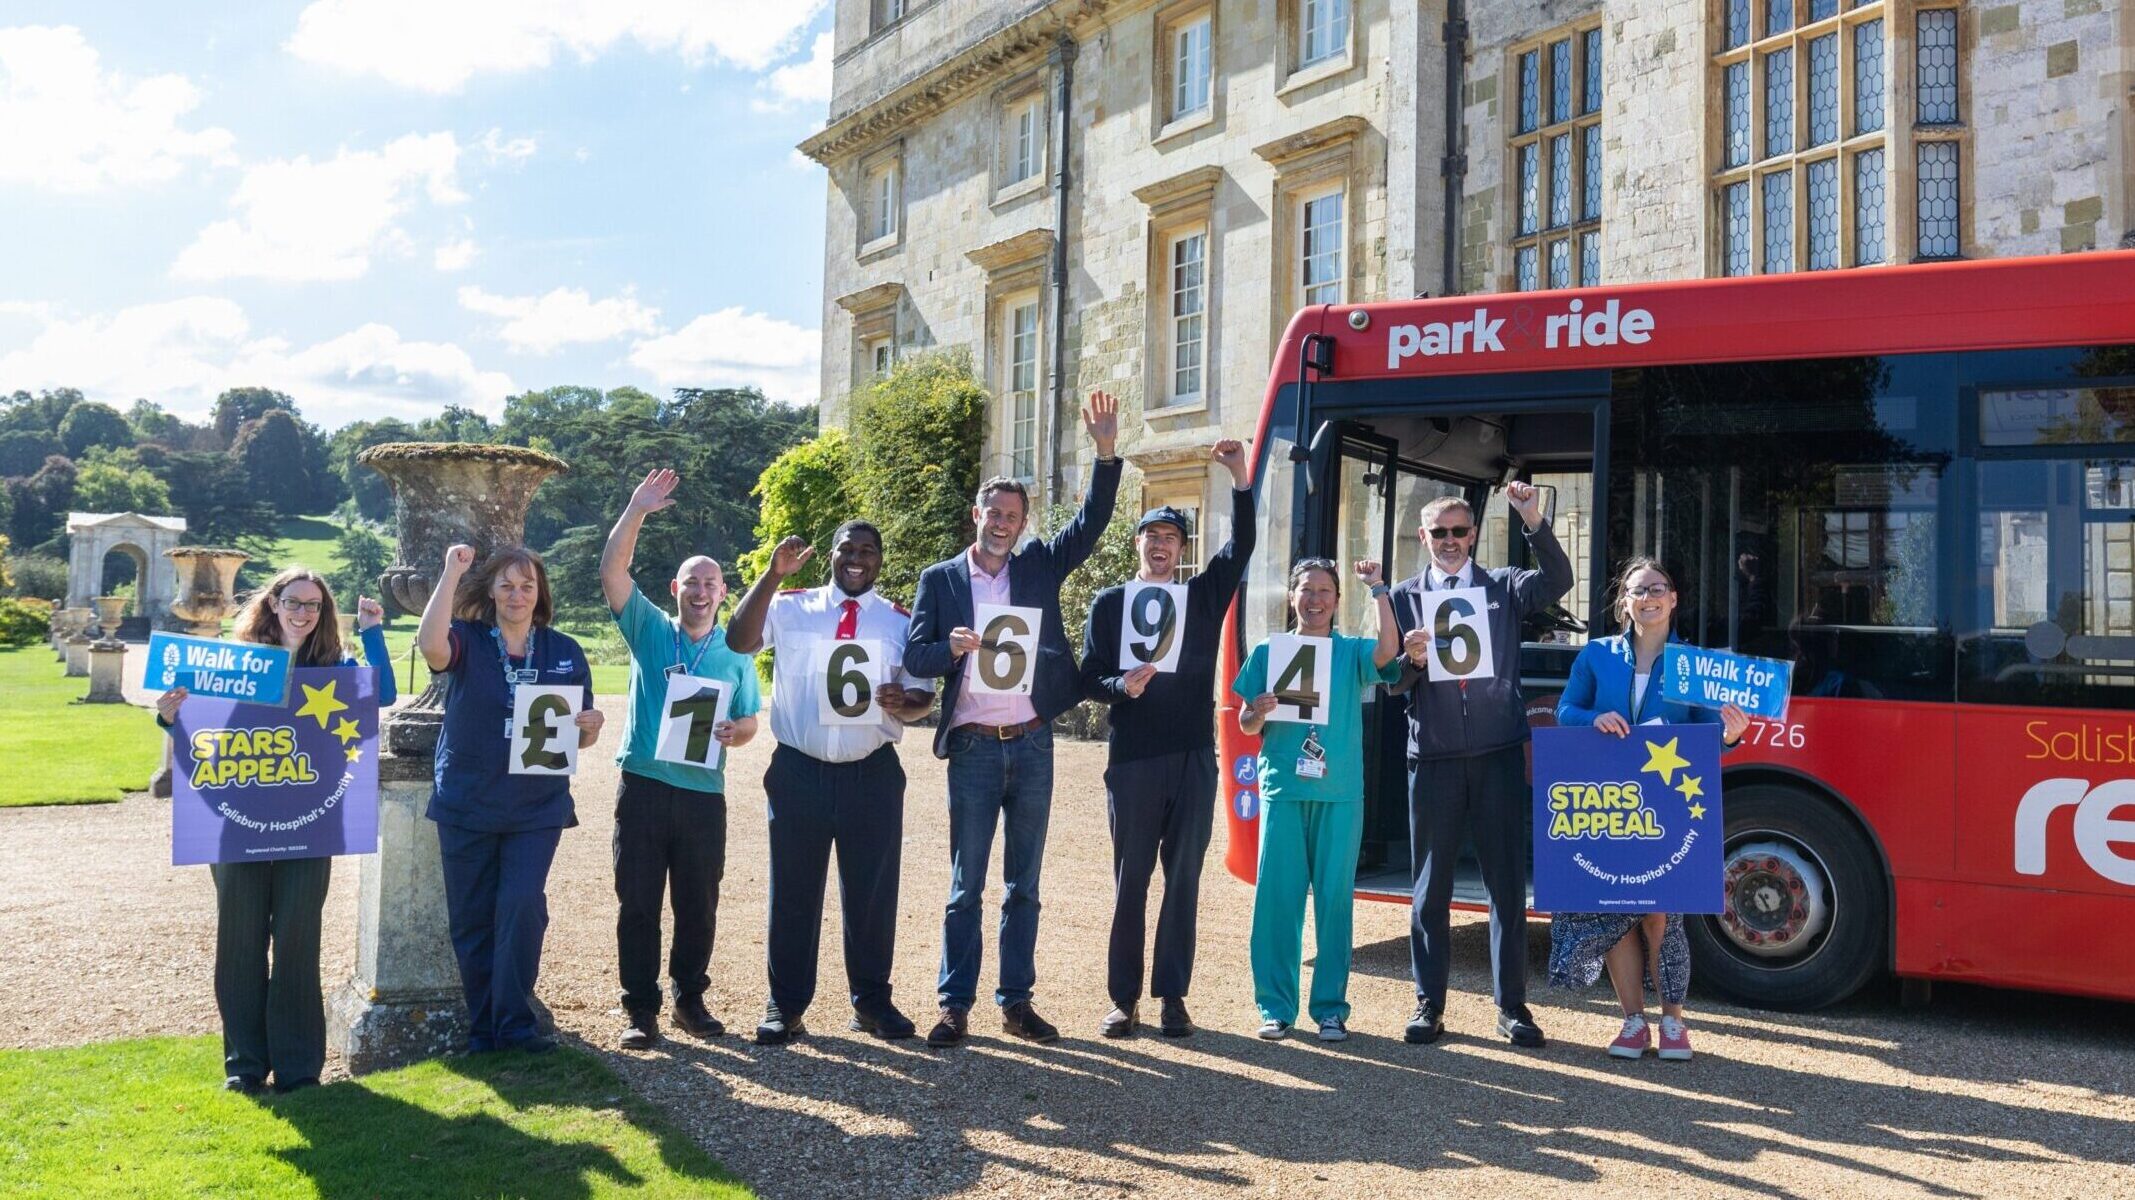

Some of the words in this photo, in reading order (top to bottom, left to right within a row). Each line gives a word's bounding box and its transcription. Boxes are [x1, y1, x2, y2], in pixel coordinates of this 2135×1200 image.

[1387, 308, 1506, 370] park
[1545, 298, 1655, 349] ride
[1130, 586, 1177, 663] 9
[1435, 598, 1481, 676] 6
[186, 645, 237, 671] Walk
[241, 649, 273, 674] for
[827, 644, 872, 718] 6
[1695, 655, 1739, 682] Walk
[1745, 664, 1775, 688] for
[194, 670, 257, 697] Wards
[1273, 644, 1320, 720] 4
[1703, 680, 1760, 709] Wards
[192, 727, 295, 759] STARS
[521, 694, 571, 770] £
[669, 686, 720, 764] 1
[1740, 721, 1806, 748] 726
[2025, 720, 2135, 764] Salis
[192, 754, 317, 787] APPEAL
[217, 801, 268, 833] Salisbury
[269, 808, 326, 832] Hospital's
[323, 771, 355, 809] Charity
[1550, 784, 1641, 811] STARS
[1550, 809, 1662, 837] APPEAL
[1572, 852, 1618, 885] Salisbury
[1620, 864, 1672, 885] Hospital's
[1670, 828, 1699, 865] Charity
